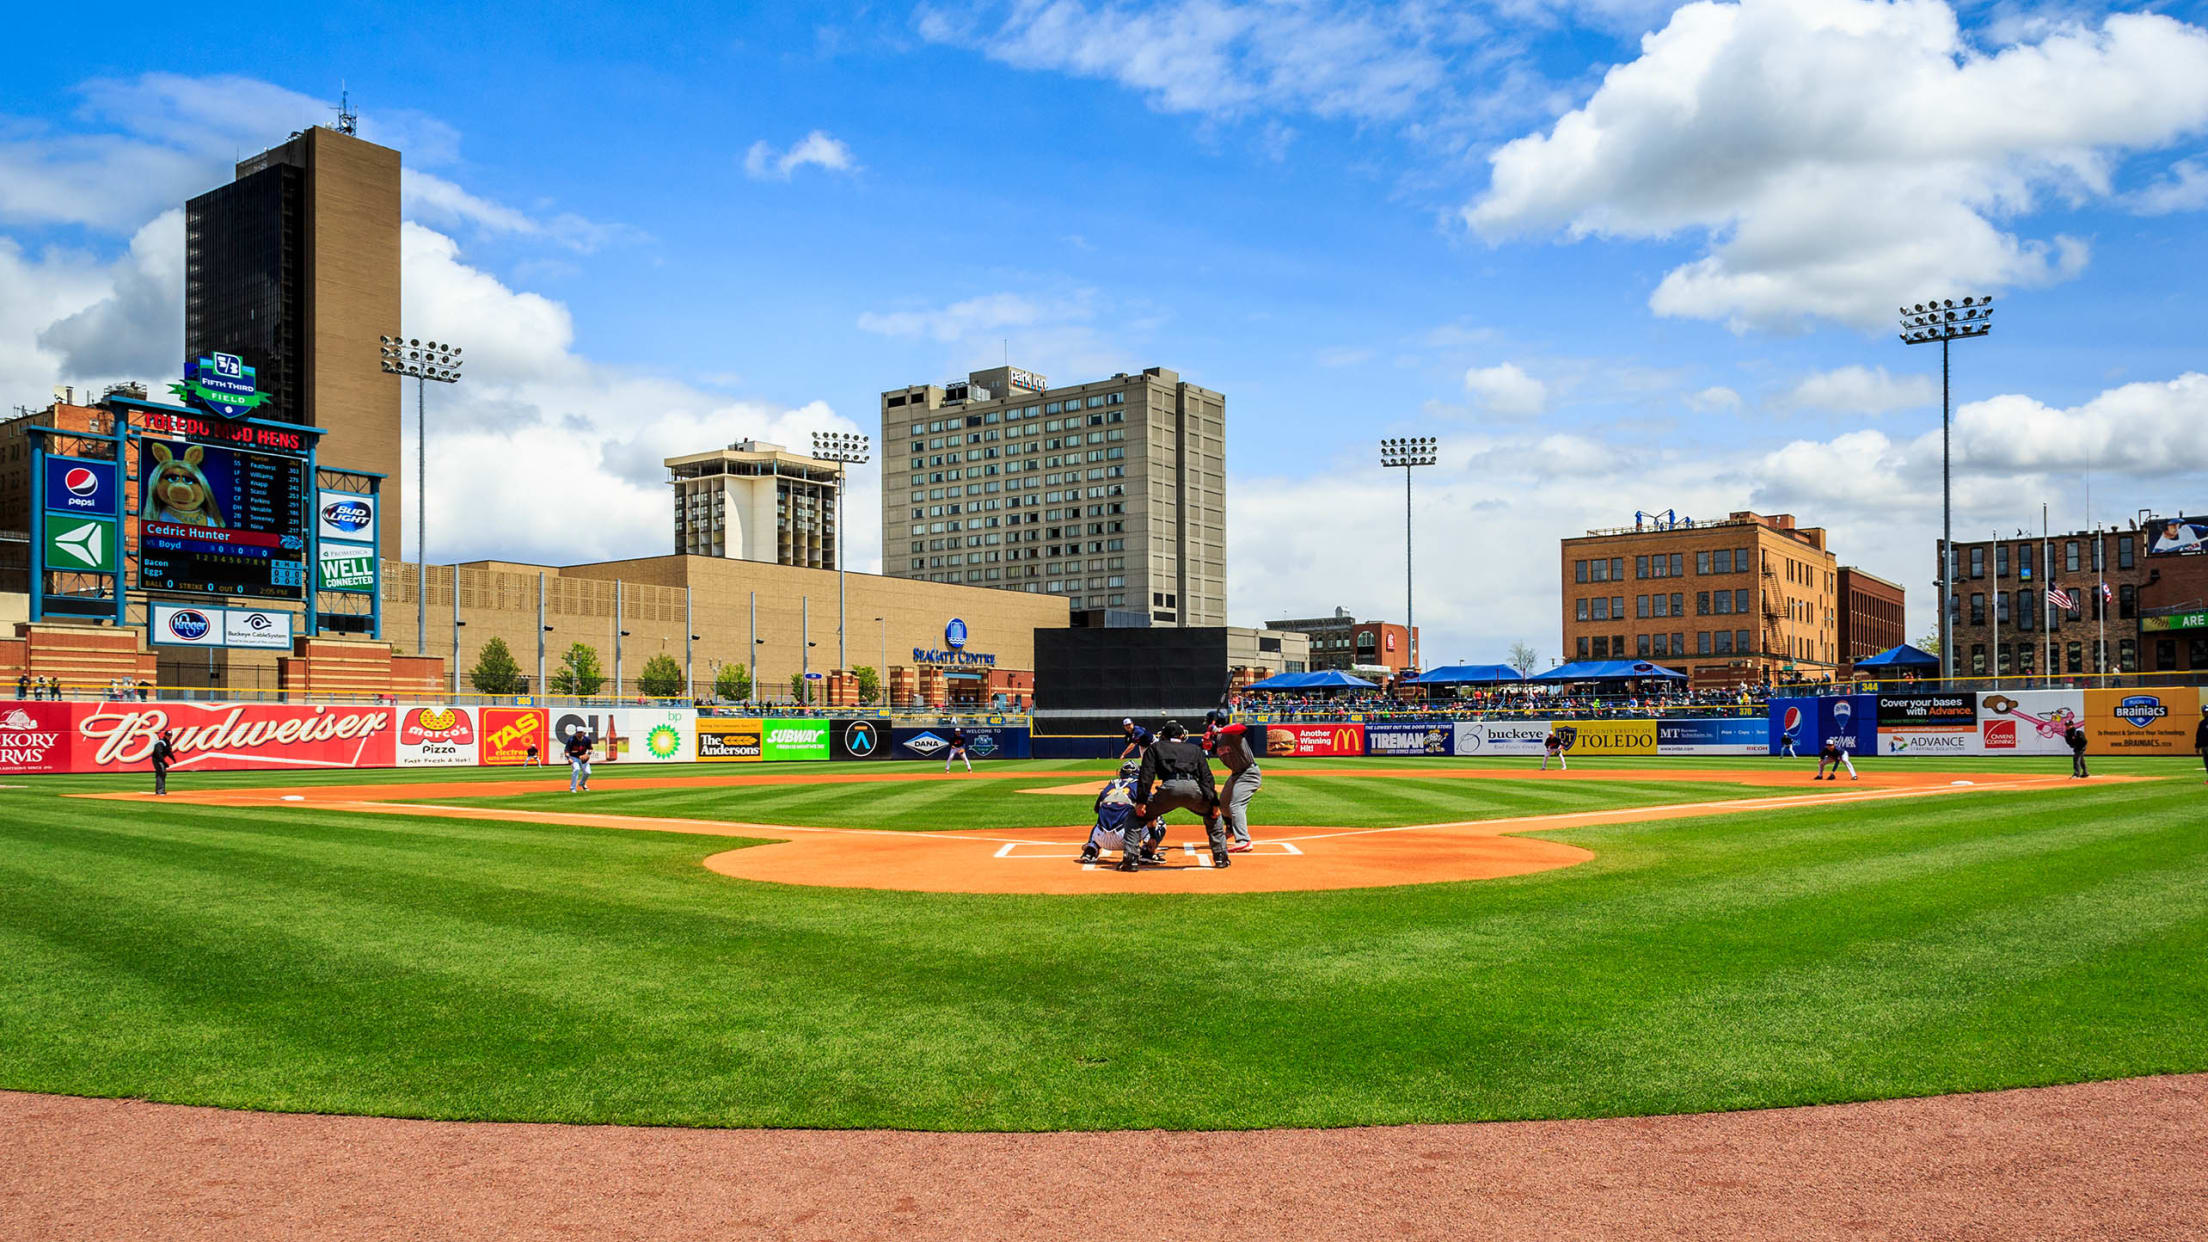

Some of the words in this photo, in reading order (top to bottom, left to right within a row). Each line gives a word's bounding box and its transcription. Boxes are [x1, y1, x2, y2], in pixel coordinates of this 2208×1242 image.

[1010, 369, 1031, 386] park
[201, 377, 227, 389] FIFTH
[227, 381, 254, 393] THIRD
[211, 392, 246, 404] FIELD
[143, 412, 210, 436] TOLEDO
[214, 422, 253, 442] MUD
[257, 430, 300, 450] HENS
[68, 498, 95, 507] pepsi
[336, 505, 367, 517] BUD
[329, 512, 370, 524] LIGHT
[147, 523, 186, 537] Cedric
[189, 527, 231, 541] Hunter
[159, 540, 182, 551] Boyd
[144, 558, 169, 567] Bacon
[320, 558, 373, 579] WELL
[144, 567, 163, 577] Eggs
[145, 580, 163, 588] BALL
[178, 582, 203, 590] STRIKE
[218, 585, 233, 593] OUT
[326, 576, 374, 588] CONNECTED
[174, 613, 207, 637] Kroger
[2182, 614, 2205, 627] ARE
[228, 630, 251, 638] Buckeye
[913, 647, 956, 664] SEAGATE
[958, 649, 996, 665] CENTRE
[1862, 683, 1879, 691] 344
[1880, 698, 1908, 707] Cover
[1909, 699, 1932, 709] your
[1933, 697, 1963, 706] bases
[667, 711, 682, 722] bp
[1906, 706, 1927, 715] with
[1928, 706, 1974, 715] Advance.
[79, 706, 388, 765] Budweiser
[487, 713, 539, 750] TAS
[766, 729, 825, 743] SUBWAY
[1300, 729, 1331, 737] Another
[1488, 728, 1544, 741] buckeye
[1660, 728, 1680, 738] MT
[0, 733, 59, 749] KORY
[700, 734, 722, 745] The
[914, 740, 939, 748] DANA
[1300, 738, 1332, 746] Winning
[1370, 733, 1424, 748] TIREMAN
[1578, 734, 1653, 748] TOLEDO
[1910, 736, 1965, 746] ADVANCE
[422, 745, 456, 754] Pizza
[700, 744, 760, 755] Andersons
